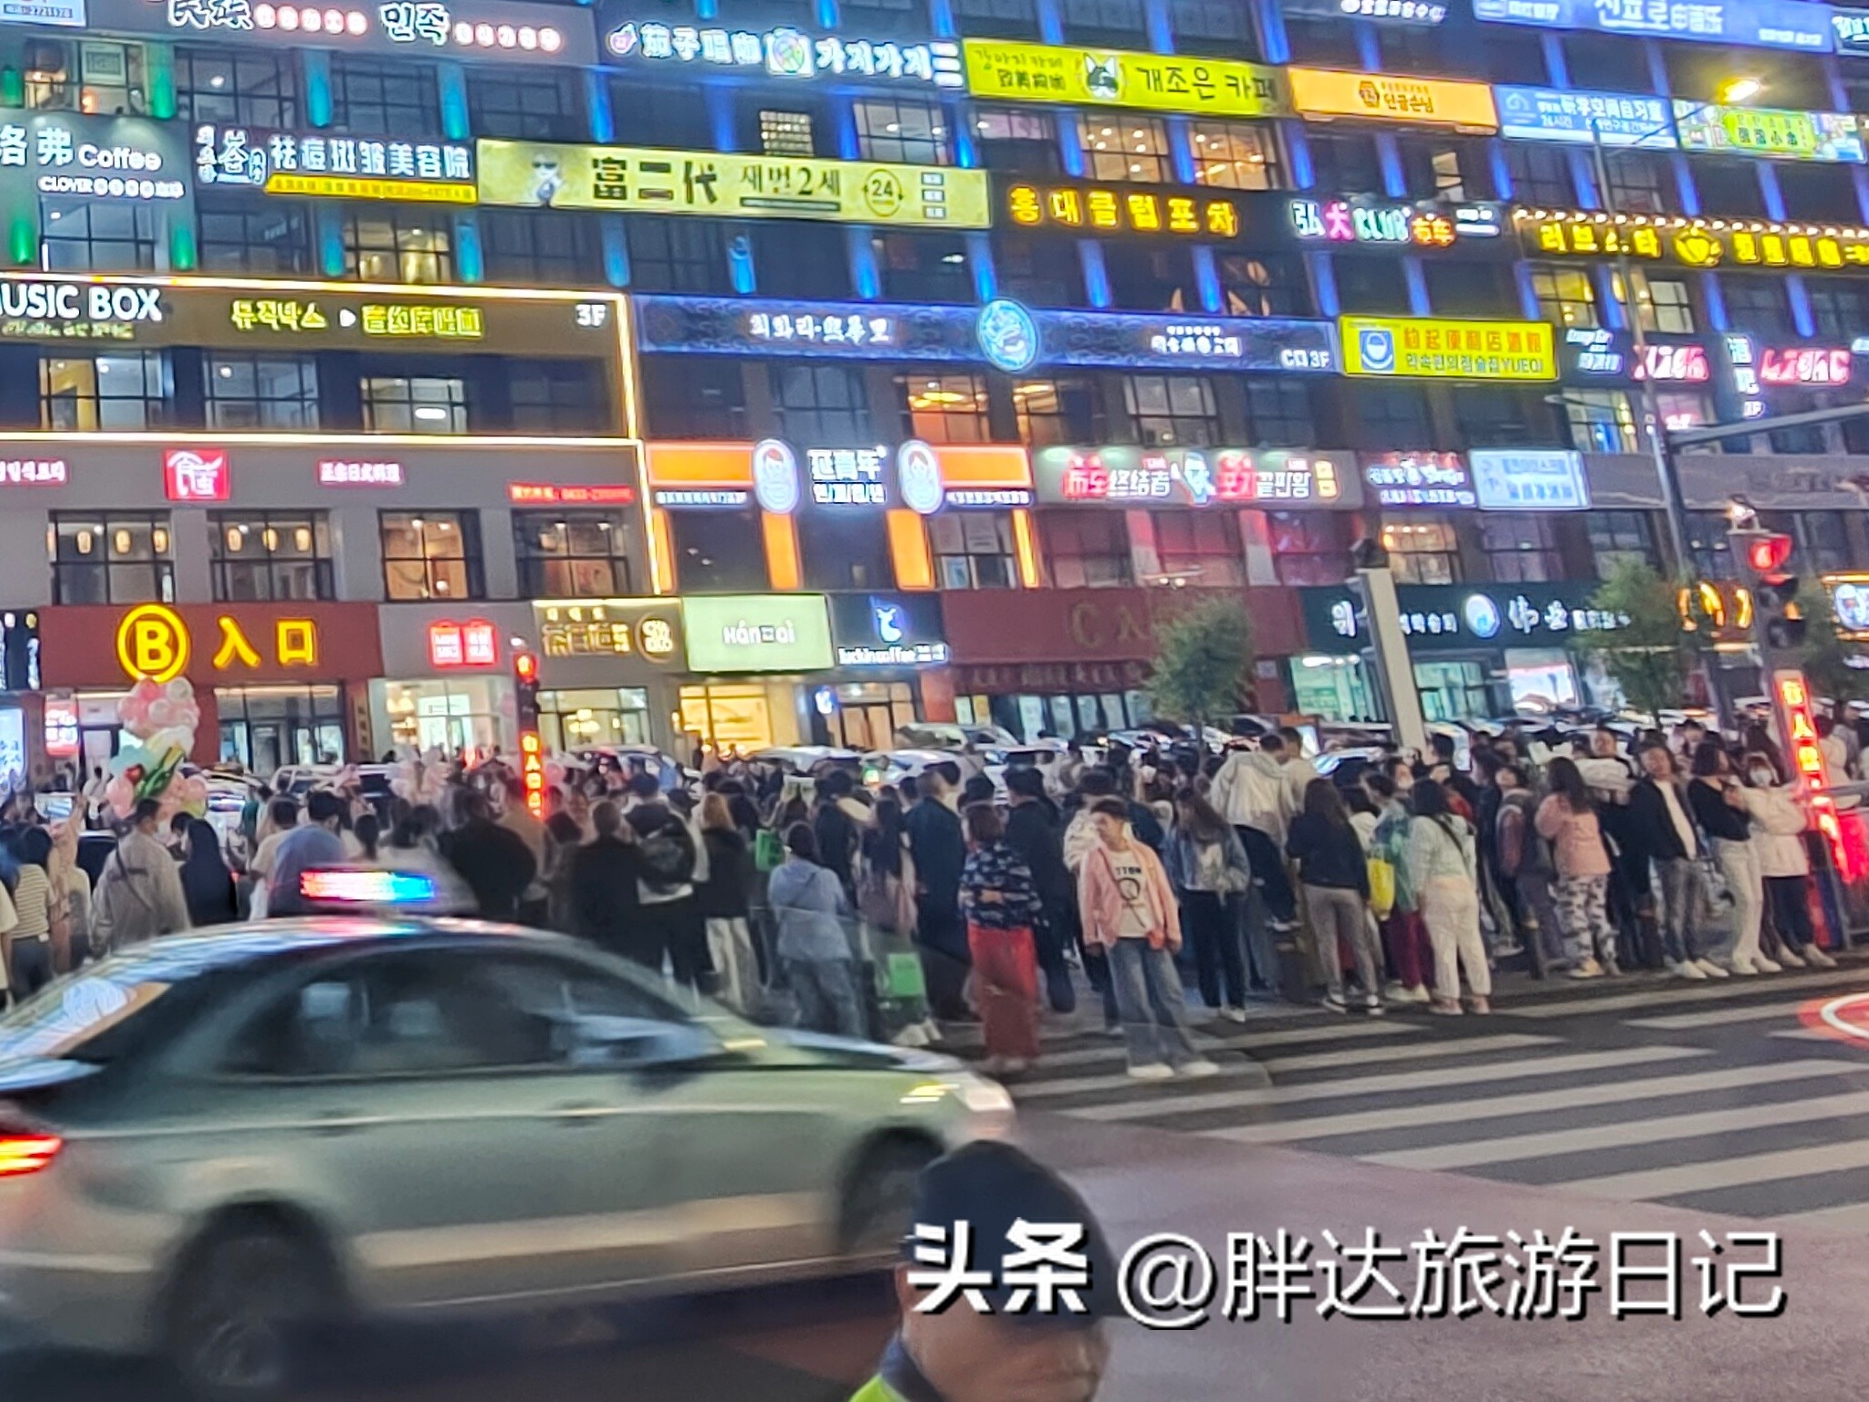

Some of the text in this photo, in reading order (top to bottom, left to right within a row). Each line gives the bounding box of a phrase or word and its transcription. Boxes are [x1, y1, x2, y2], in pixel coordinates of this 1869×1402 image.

[378, 3, 452, 46] 민족
[814, 36, 934, 81] 가지가지
[77, 144, 162, 172] Coffee
[591, 155, 718, 205] 富二代
[870, 179, 894, 198] 24
[89, 285, 163, 322] BOX
[575, 304, 608, 328] 3F
[212, 615, 318, 670] 入口
